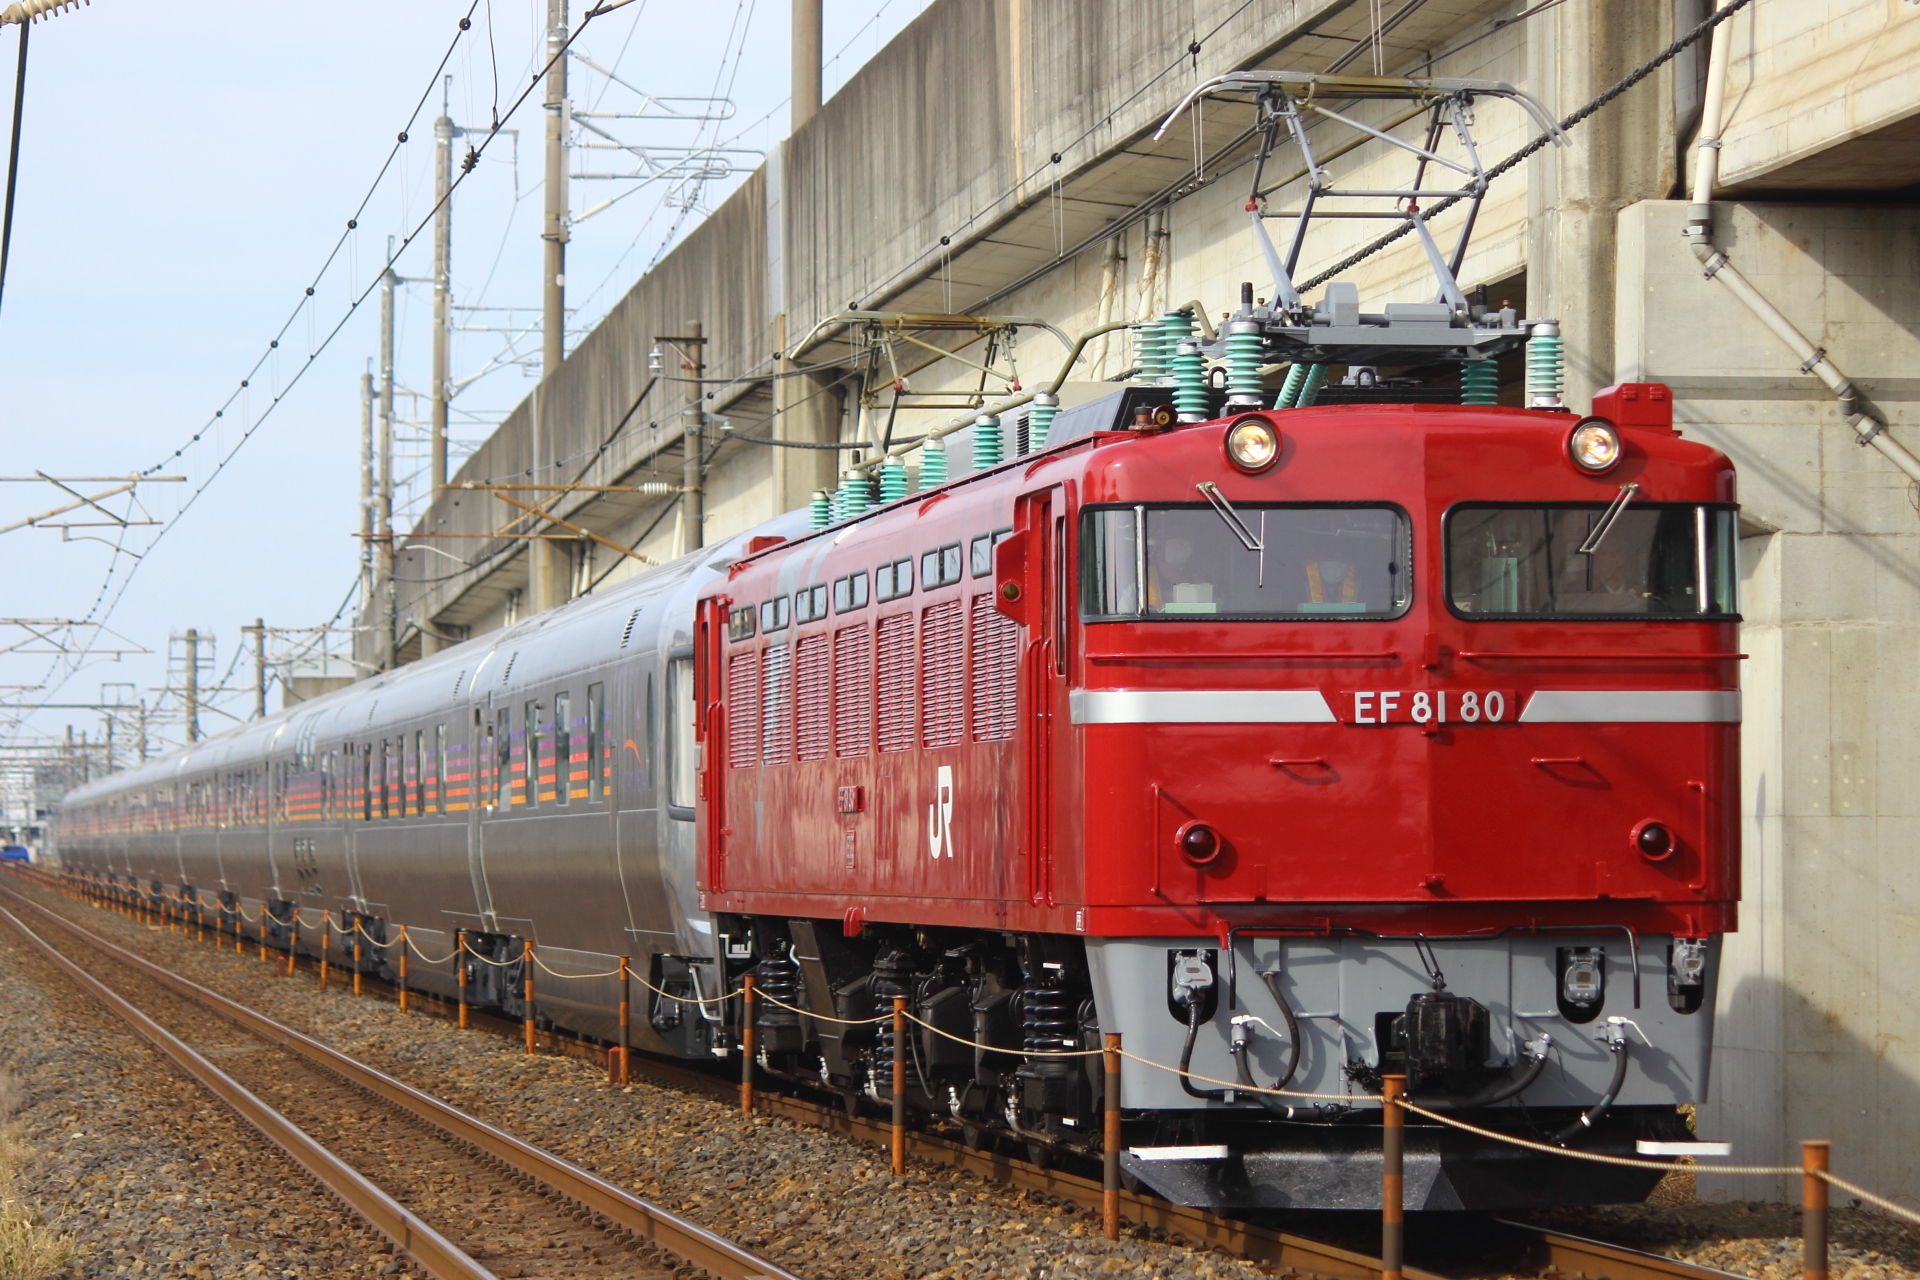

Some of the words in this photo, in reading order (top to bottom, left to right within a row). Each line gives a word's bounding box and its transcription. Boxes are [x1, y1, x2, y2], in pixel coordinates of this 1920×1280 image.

[1354, 691, 1400, 724] EF
[1411, 690, 1446, 724] 81
[1460, 690, 1505, 723] 80
[929, 765, 953, 860] JR
